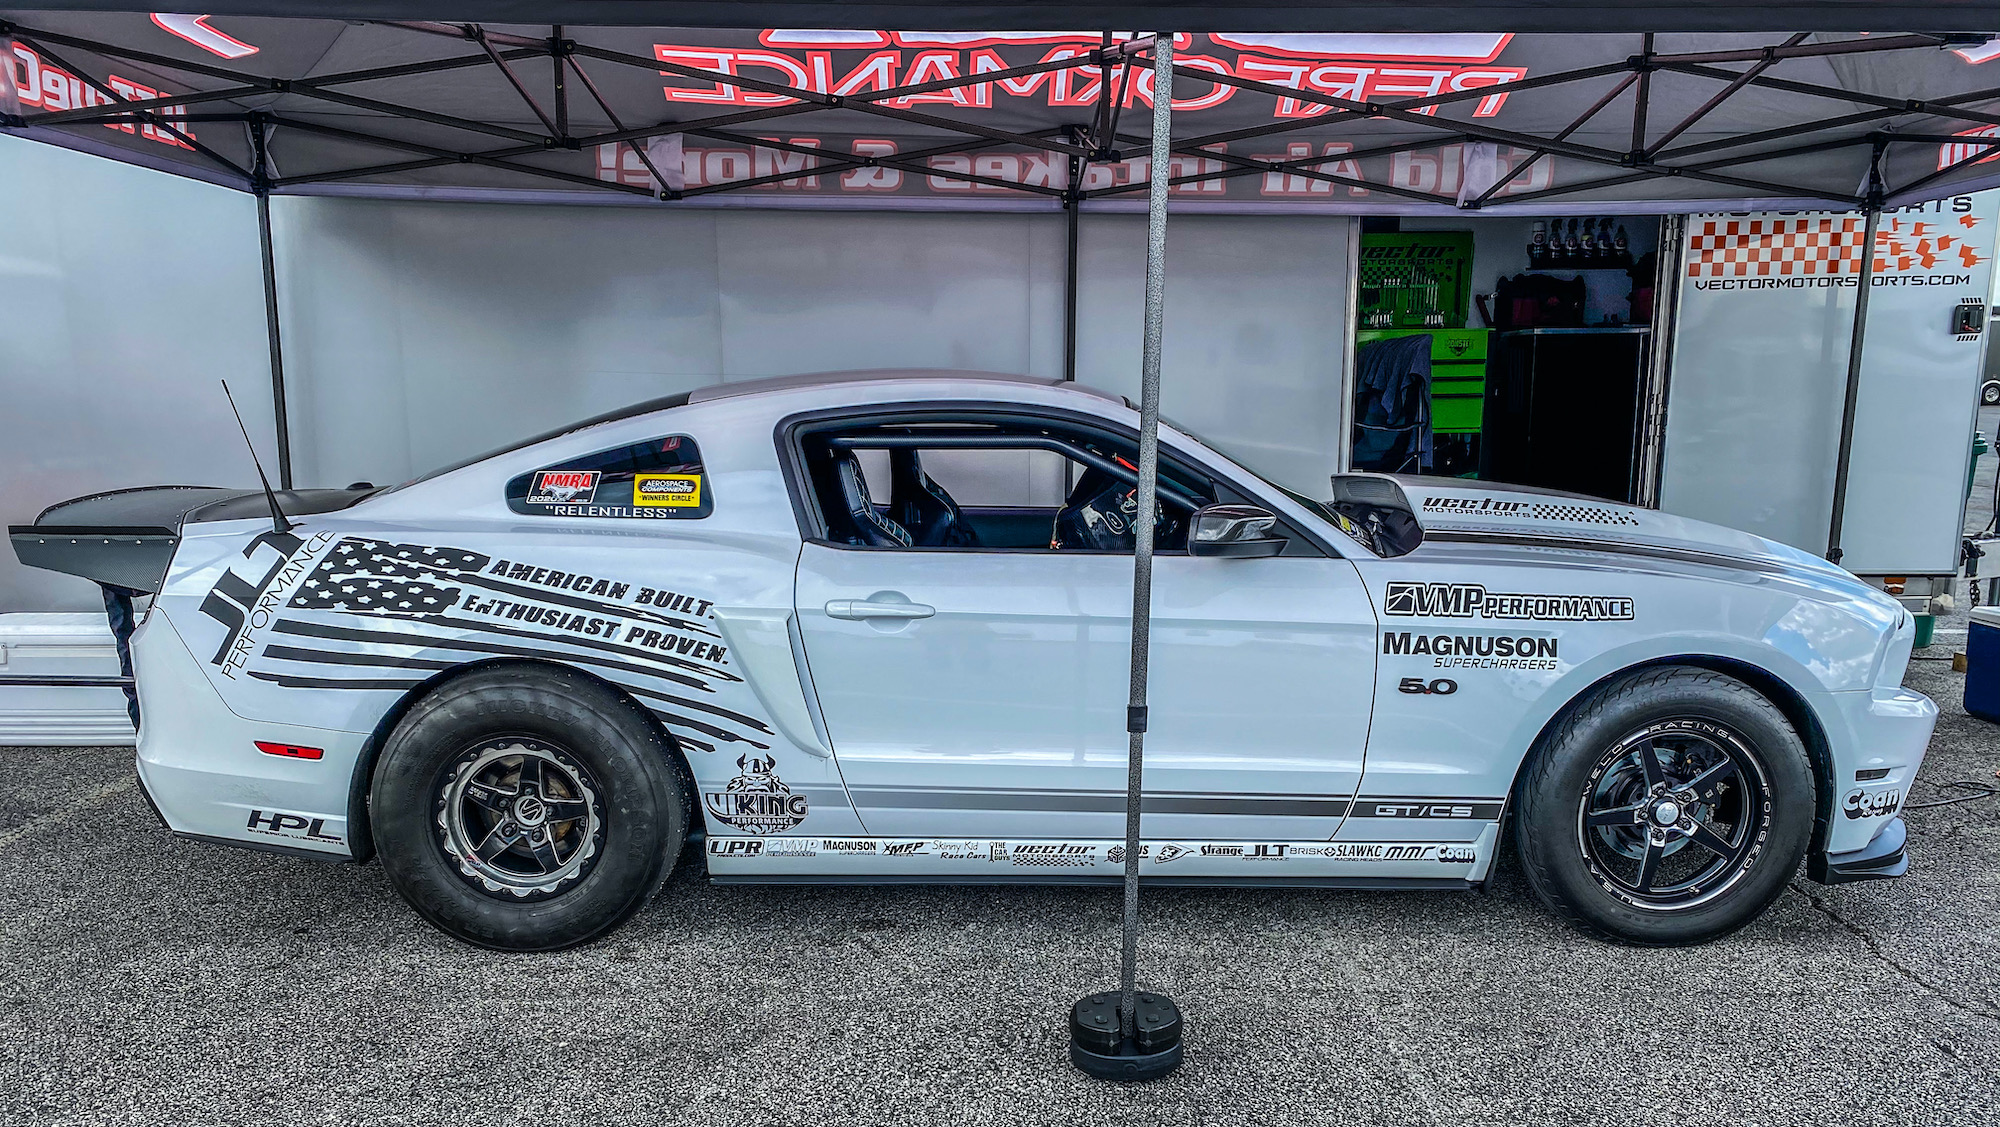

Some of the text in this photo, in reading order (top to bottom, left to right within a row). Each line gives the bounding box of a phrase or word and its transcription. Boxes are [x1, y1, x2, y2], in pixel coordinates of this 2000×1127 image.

[1694, 274, 1971, 291] VECTORMOTORSORTS.COM
[539, 473, 593, 490] NMRA
[1423, 507, 1531, 519] MOTORSPORTS
[488, 556, 716, 620] AMERICAN BUILT.
[221, 529, 336, 681] PERFORMANCE
[1414, 584, 1633, 618] VMP PERFORMANCE
[624, 625, 730, 665] PROVEN.
[1383, 632, 1558, 657] MAGNUSON
[1433, 657, 1558, 670] SUPERCHARGERS
[1398, 678, 1458, 695] 5.0
[1650, 721, 1730, 738] RACING
[1582, 744, 1623, 796] WELD
[1375, 804, 1474, 817] GT/CS
[1841, 788, 1900, 817] Coan
[247, 810, 342, 840] HPL
[731, 817, 795, 825] PERFORMANCE
[1743, 784, 1771, 869] FORGED
[710, 840, 763, 854] UPR
[823, 840, 877, 850] MAGNUSON
[932, 840, 979, 853] Skinny Kid
[1200, 844, 1243, 856] Strange
[1244, 845, 1289, 856] JLT
[1437, 844, 1475, 861] Coan
